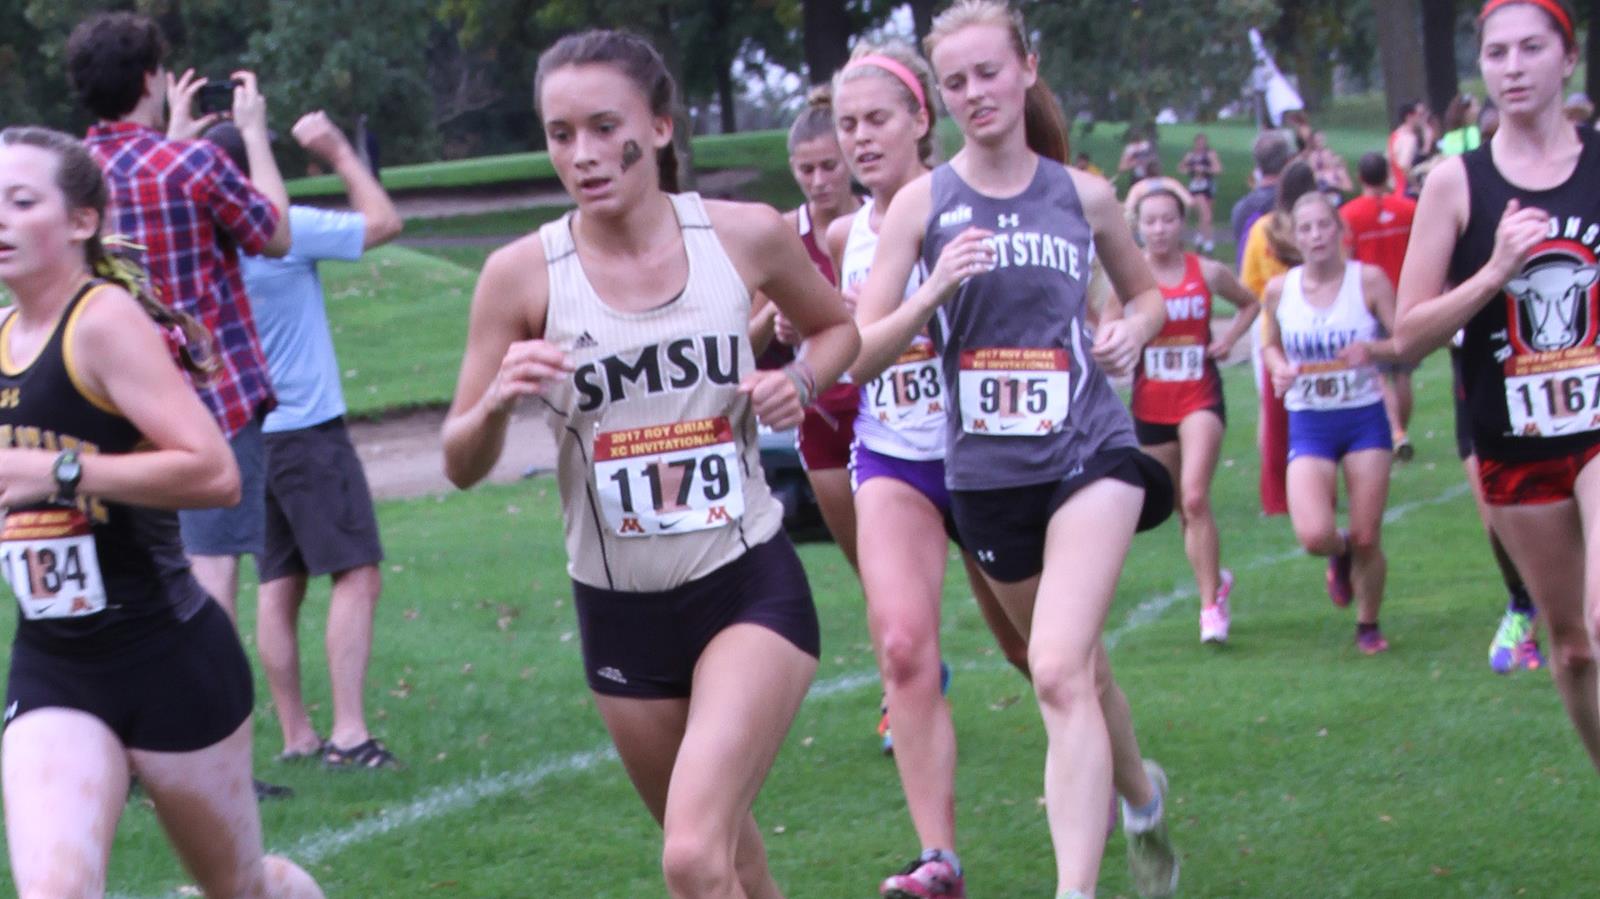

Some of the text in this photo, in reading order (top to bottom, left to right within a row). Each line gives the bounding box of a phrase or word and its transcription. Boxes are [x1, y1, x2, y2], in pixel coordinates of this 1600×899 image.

[1012, 231, 1081, 280] STATE
[574, 335, 739, 412] SMSU
[871, 366, 940, 407] 2153
[980, 378, 1048, 414] 915
[1516, 374, 1600, 417] 1167
[610, 433, 717, 457] XC INVITATIONAL
[611, 420, 715, 443] 2017 ROY GRIAK
[610, 454, 730, 513] 1179
[3, 545, 86, 595] 1134
